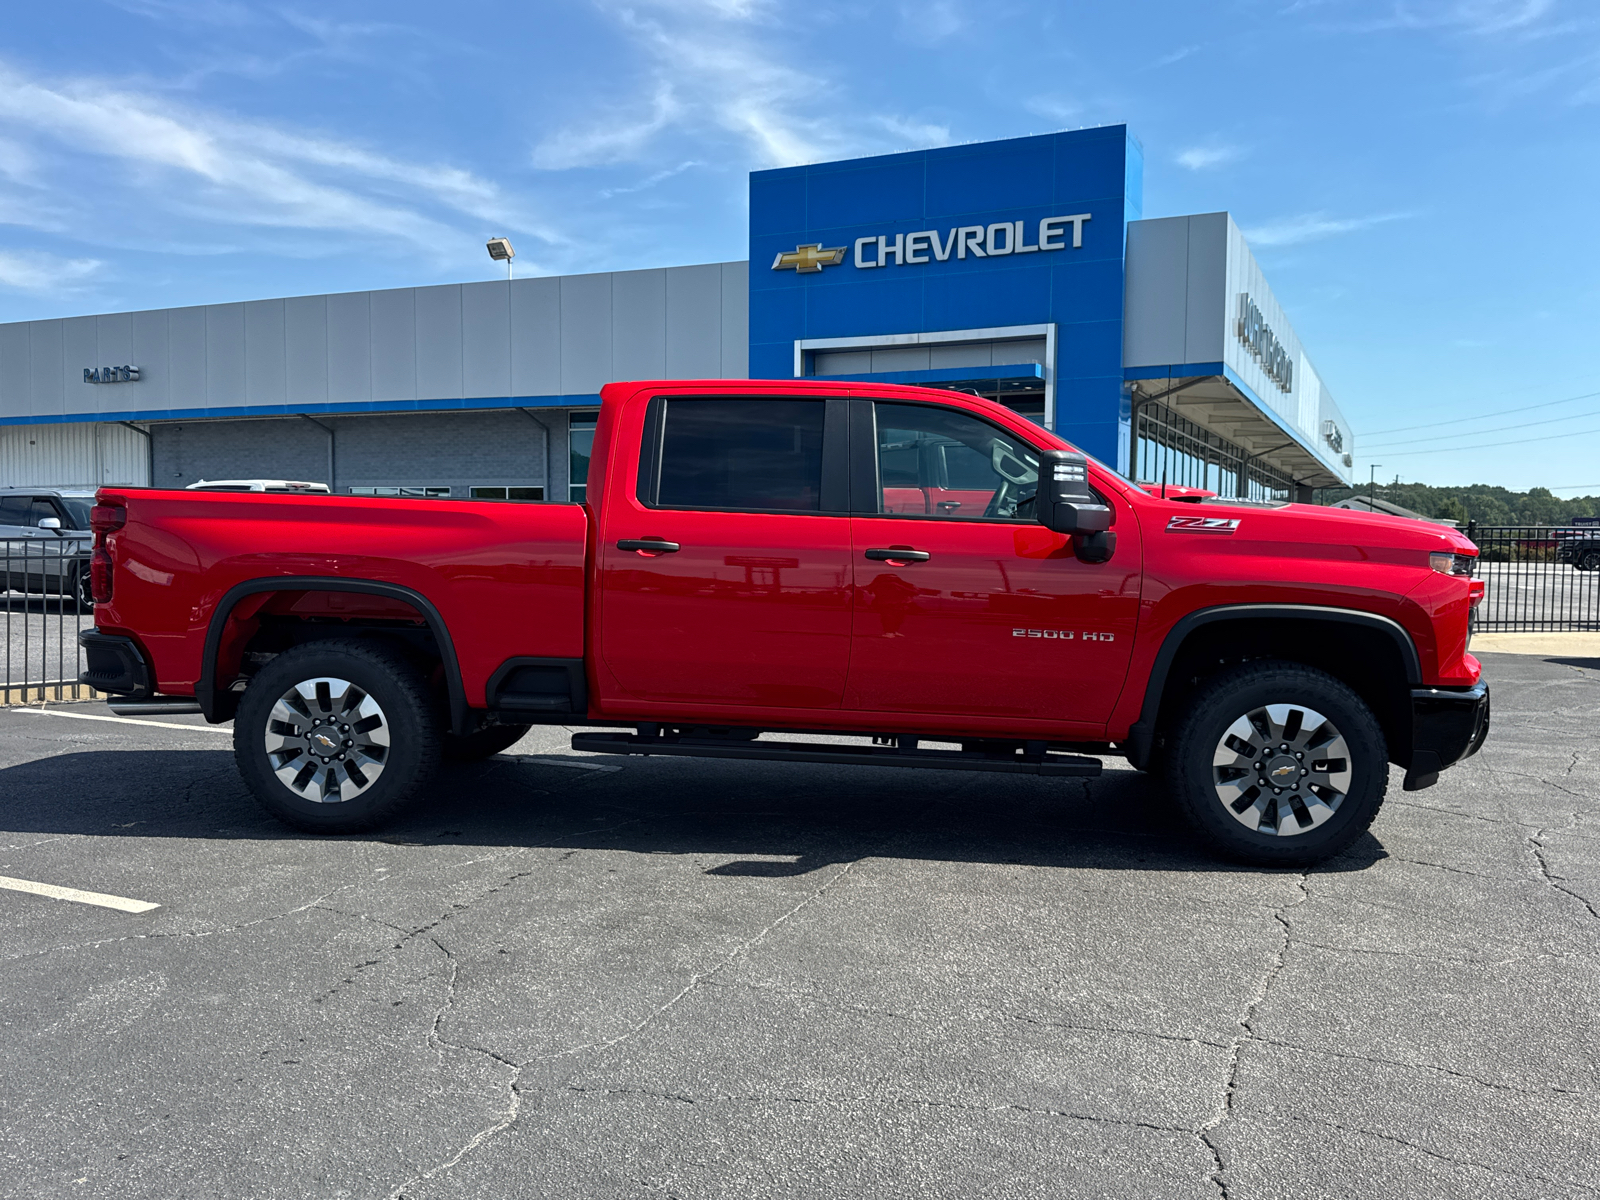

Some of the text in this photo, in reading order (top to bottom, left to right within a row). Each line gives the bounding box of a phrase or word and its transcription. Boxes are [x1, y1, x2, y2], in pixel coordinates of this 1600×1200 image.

[854, 213, 1092, 269] CHEVROLET
[83, 365, 132, 383] PARTS
[1165, 516, 1242, 533] Z71
[1012, 628, 1115, 642] 2500 HD
